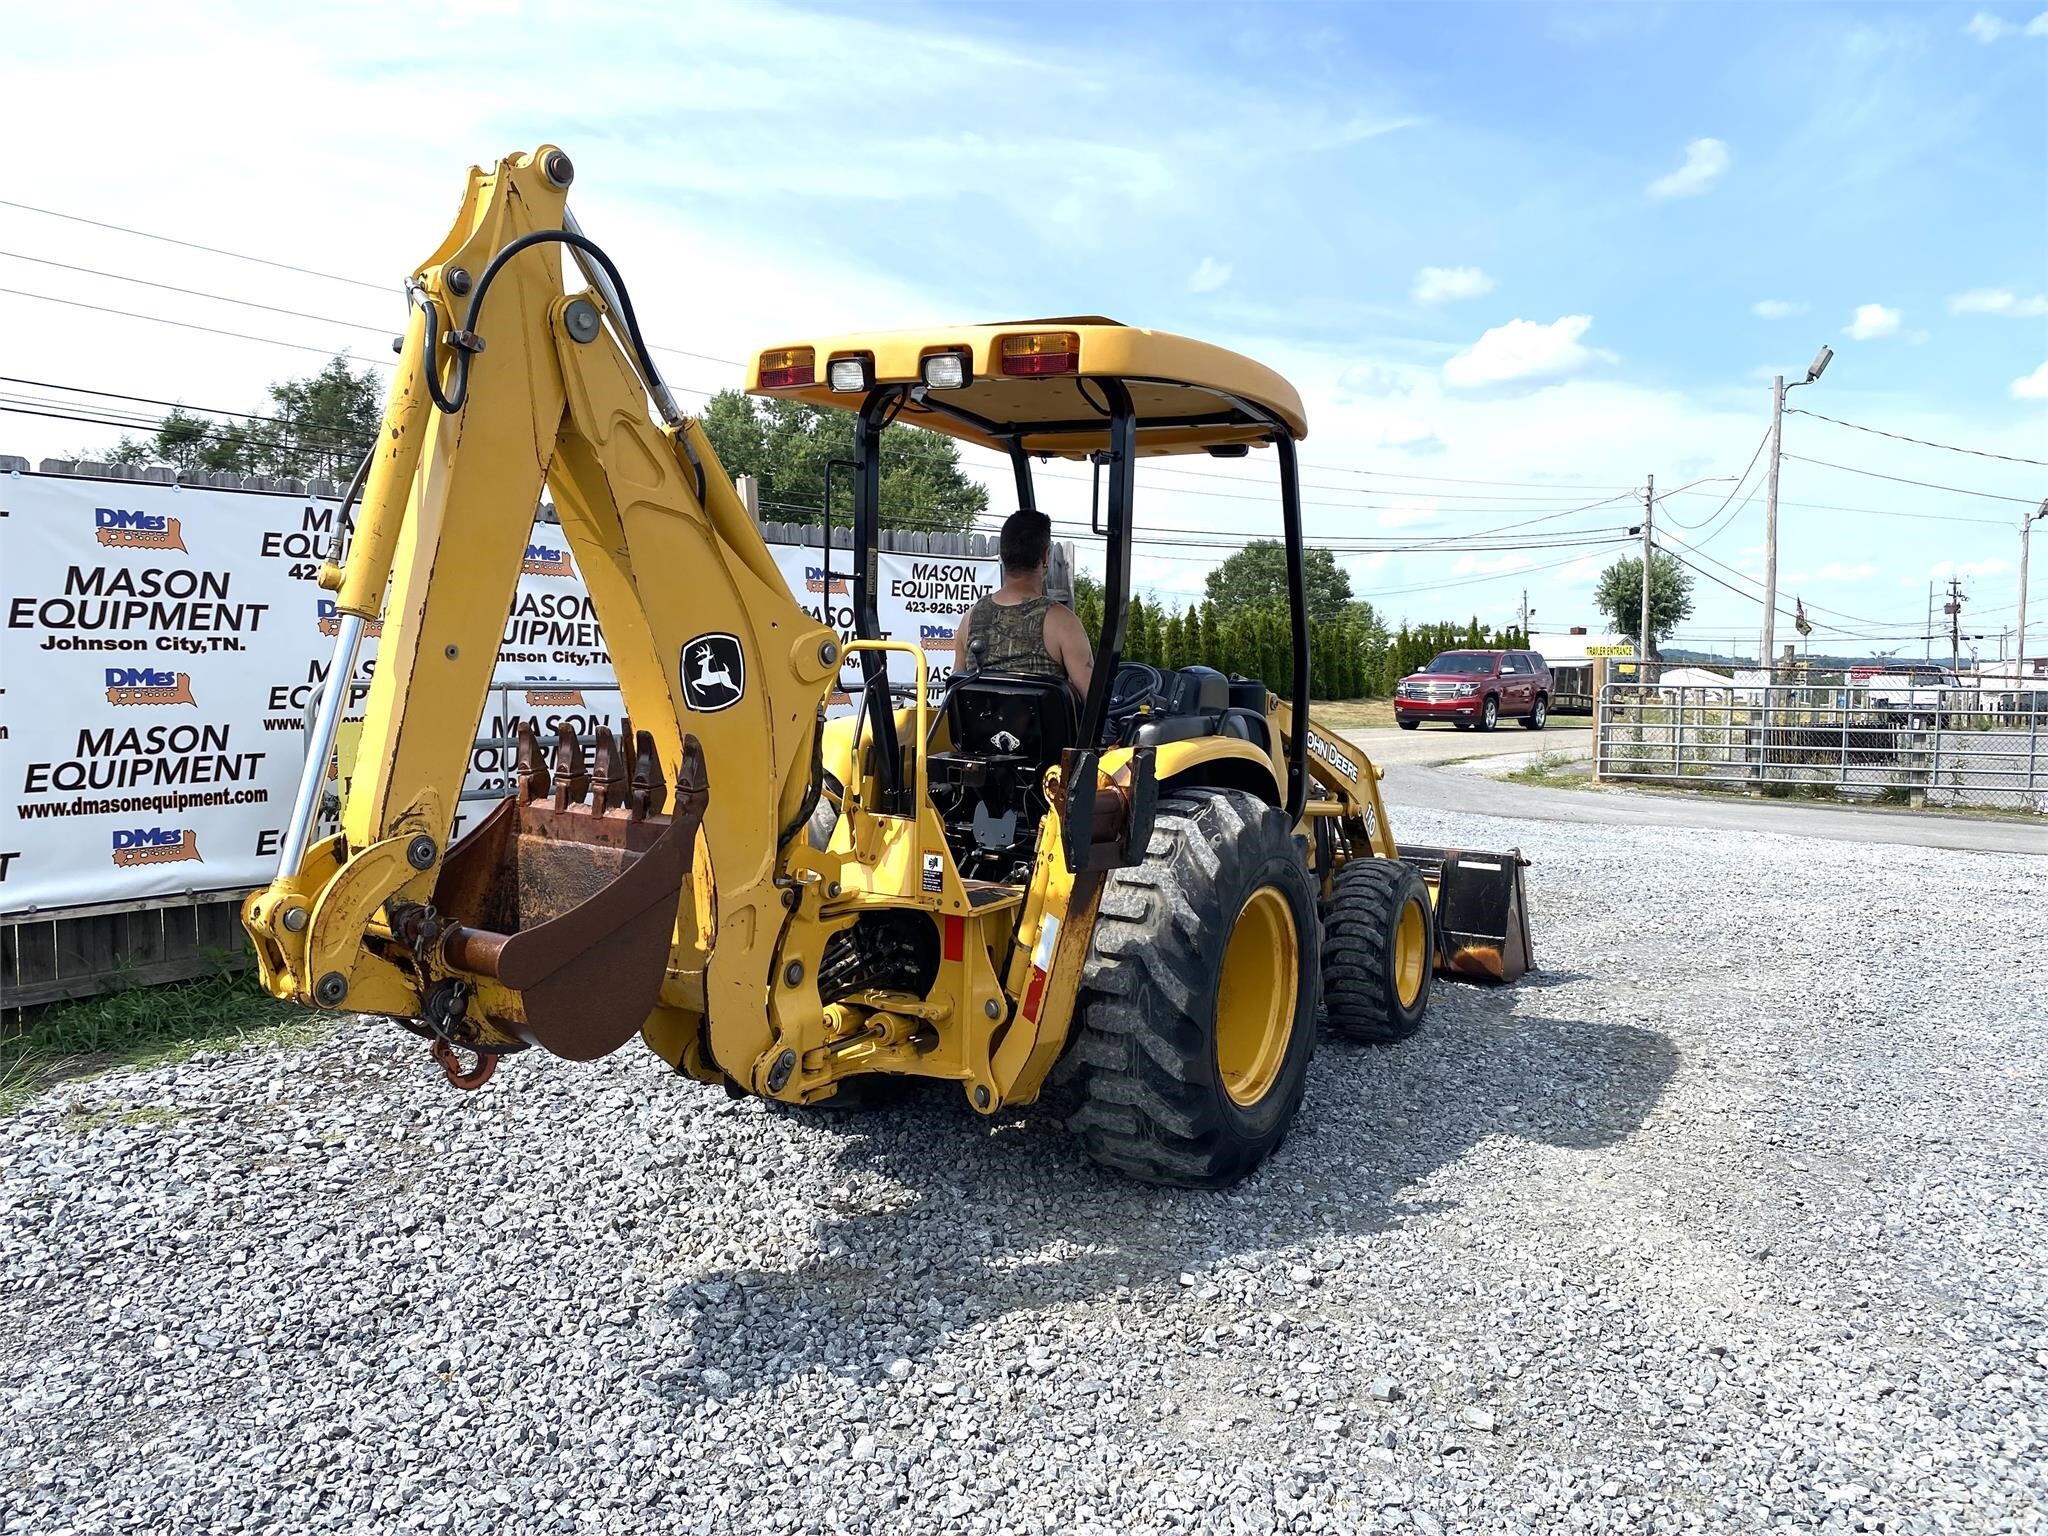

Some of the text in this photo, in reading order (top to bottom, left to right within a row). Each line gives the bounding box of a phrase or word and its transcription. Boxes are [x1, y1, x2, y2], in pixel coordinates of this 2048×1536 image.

[64, 565, 231, 600] MASON
[912, 563, 977, 583] MASON
[8, 598, 269, 632] EQUIPMENT
[905, 601, 976, 614] 423-926-38
[40, 635, 246, 654] Johnson City,TN.
[552, 651, 612, 666] City,TN
[1586, 646, 1632, 656] TRAILER ENTRANCE
[76, 724, 230, 758] MASON
[24, 753, 266, 793] EQUIPMENT
[1306, 731, 1359, 784] OHN DEERE
[17, 787, 268, 819] www.dmasonequipment.com
